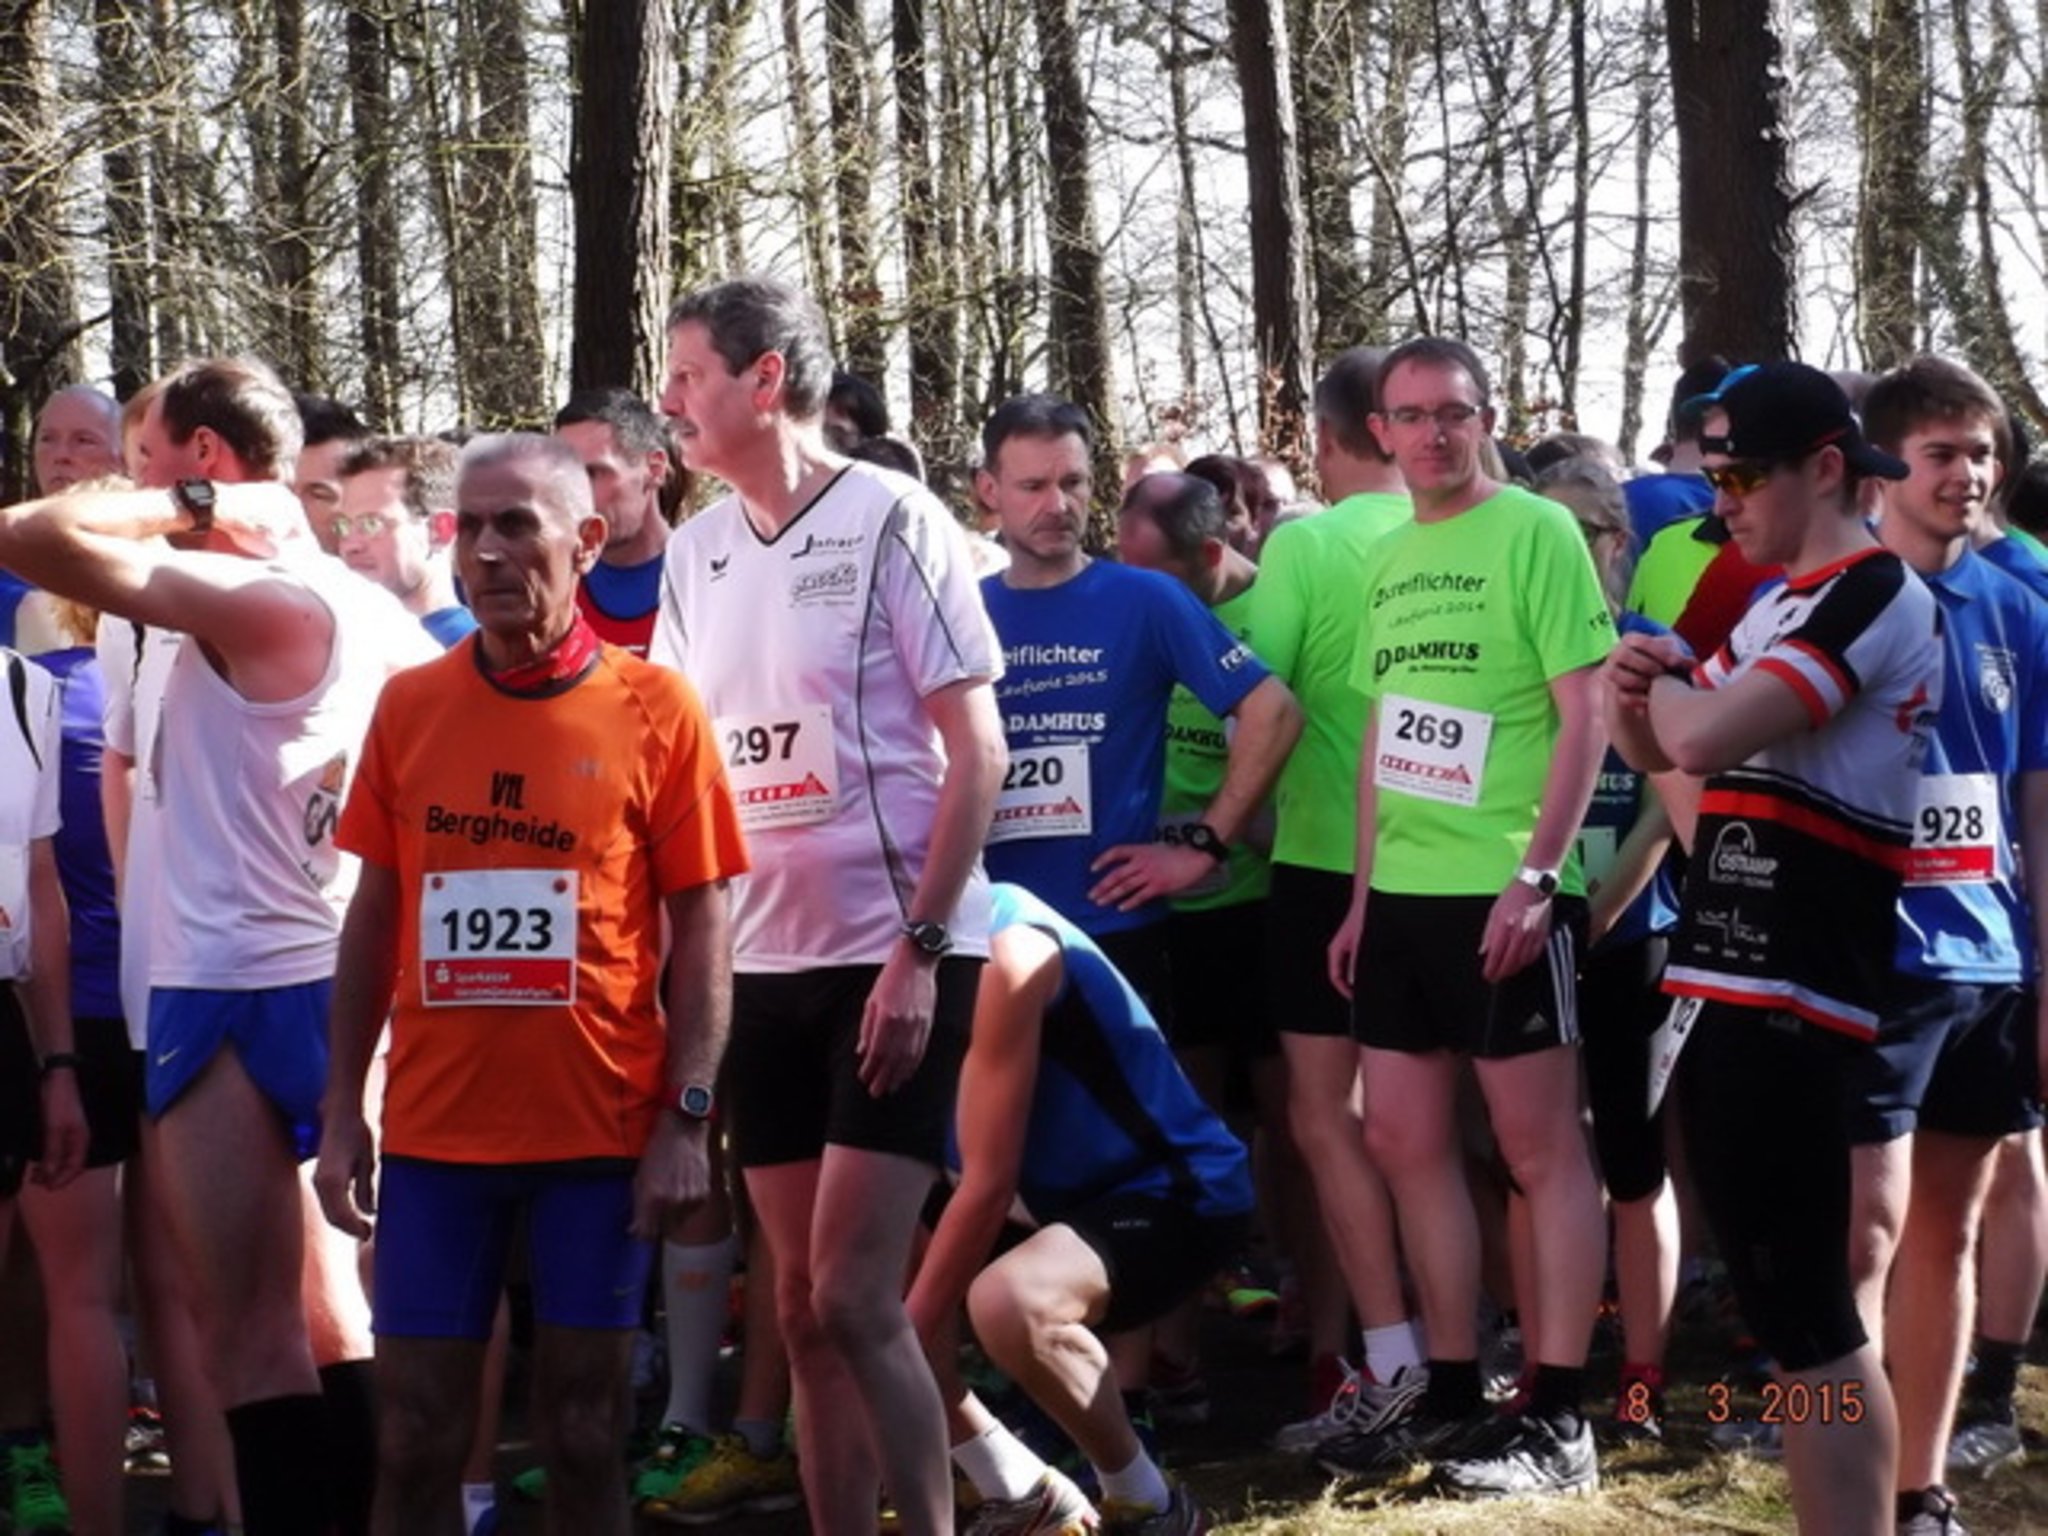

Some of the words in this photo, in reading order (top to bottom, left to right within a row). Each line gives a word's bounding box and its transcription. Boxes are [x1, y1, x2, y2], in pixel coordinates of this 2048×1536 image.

[1009, 712, 1106, 733] DAMHUS
[1395, 709, 1464, 750] 269
[726, 722, 801, 768] 297
[1001, 756, 1064, 791] 220
[425, 805, 577, 852] Bergheide
[1921, 806, 1984, 843] 928
[441, 908, 553, 951] 1923
